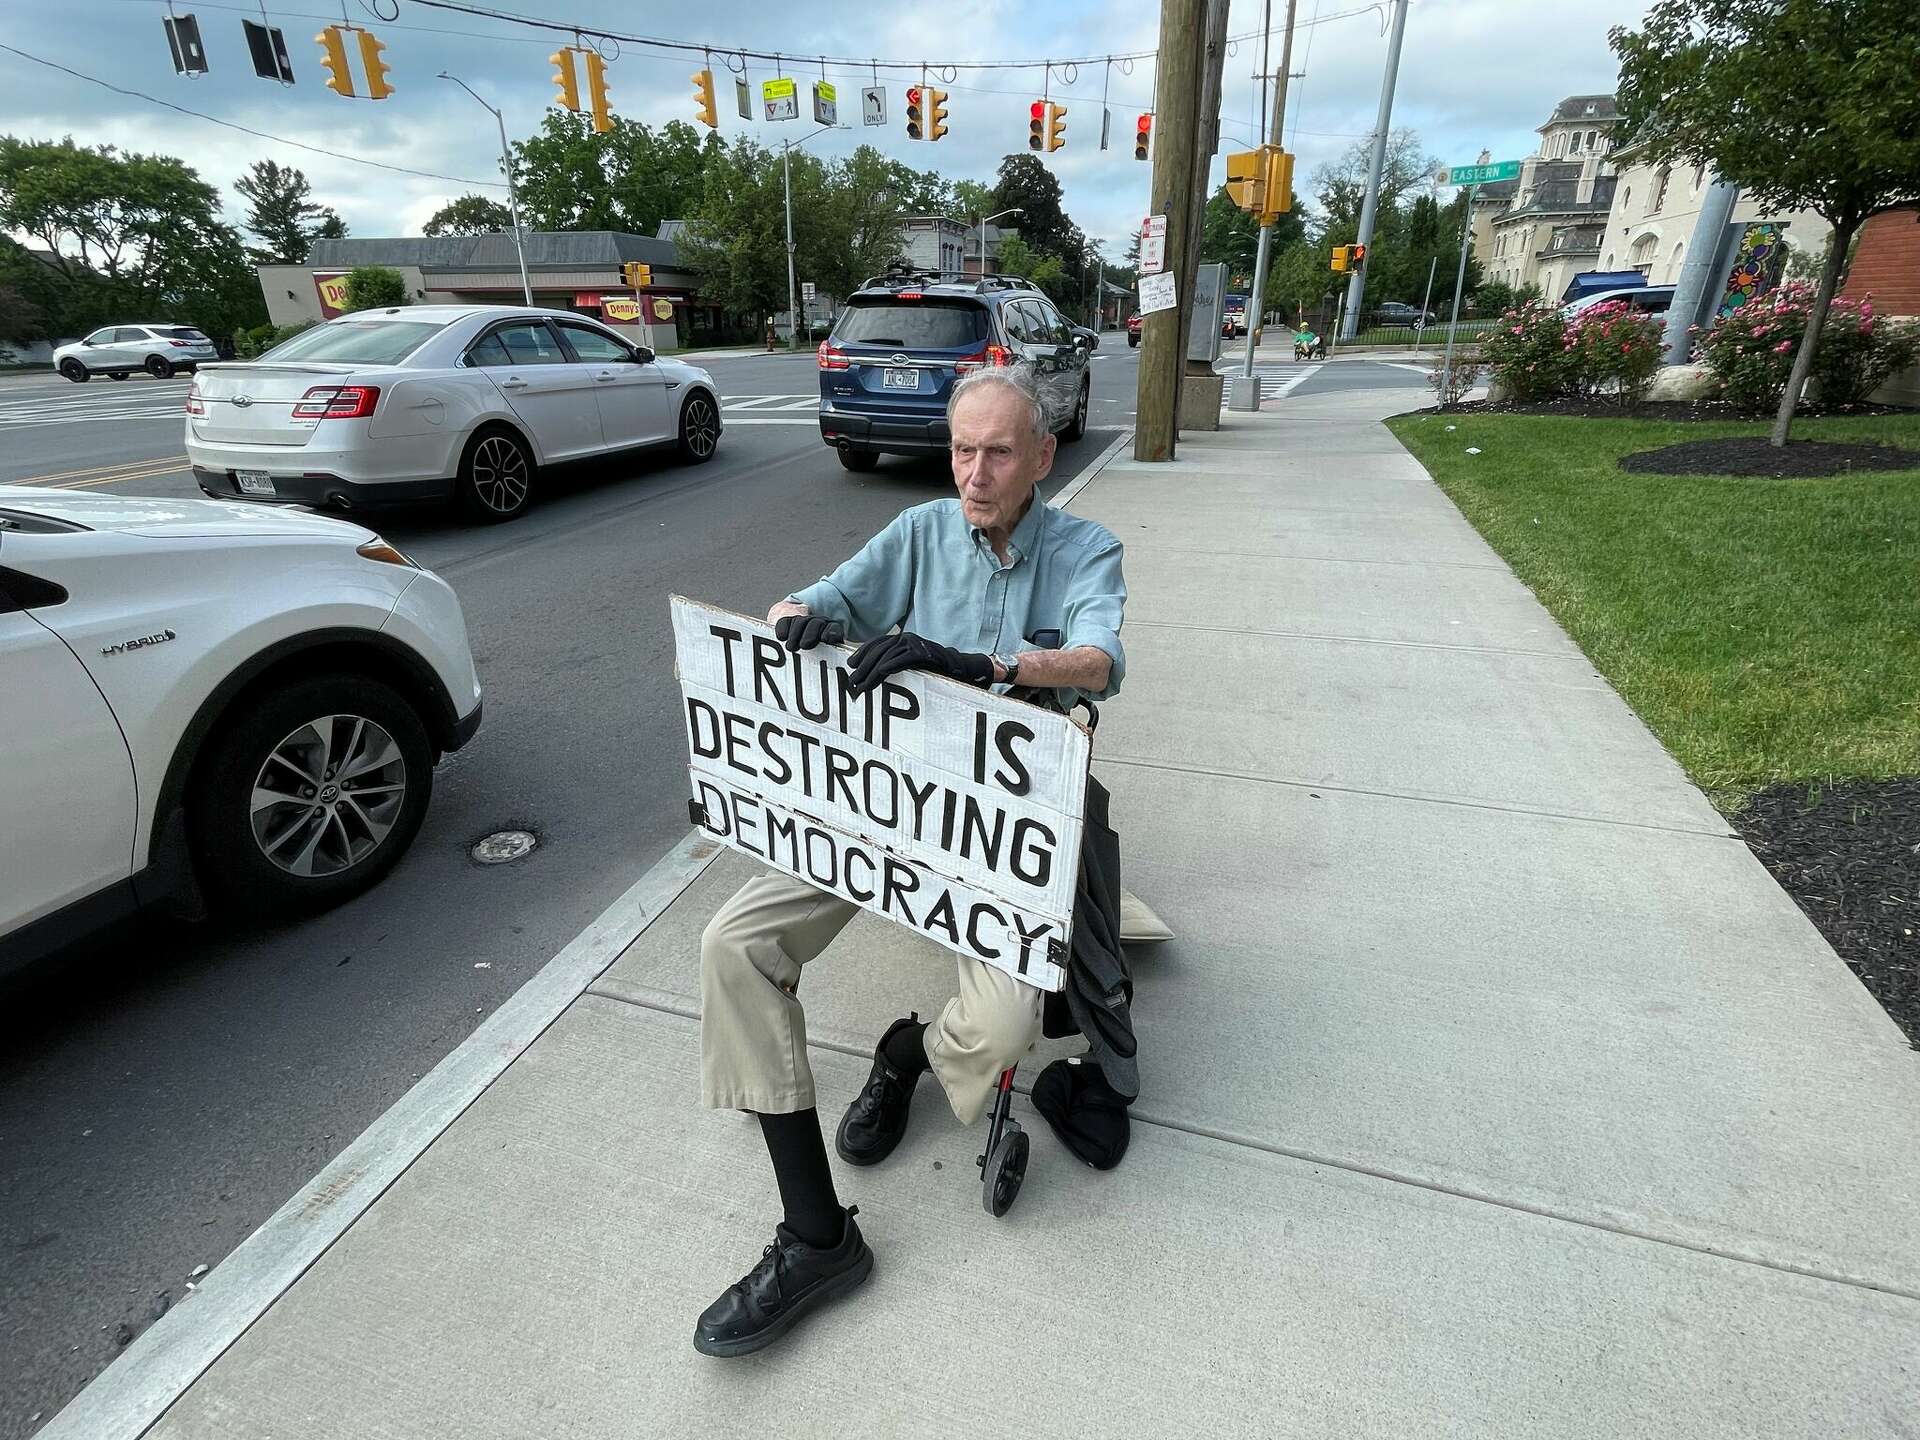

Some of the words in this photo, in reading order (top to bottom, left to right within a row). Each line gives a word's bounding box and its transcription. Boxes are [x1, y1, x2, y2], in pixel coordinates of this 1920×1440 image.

[866, 114, 883, 122] ONLY
[1452, 166, 1500, 181] EASTERN
[610, 303, 640, 315] Denny's
[101, 634, 165, 655] HYBRID
[710, 625, 921, 750] TRUMP
[973, 711, 1036, 797] IS
[687, 696, 1057, 888] DESTROYING
[697, 780, 1055, 974] DEMOCRACY
